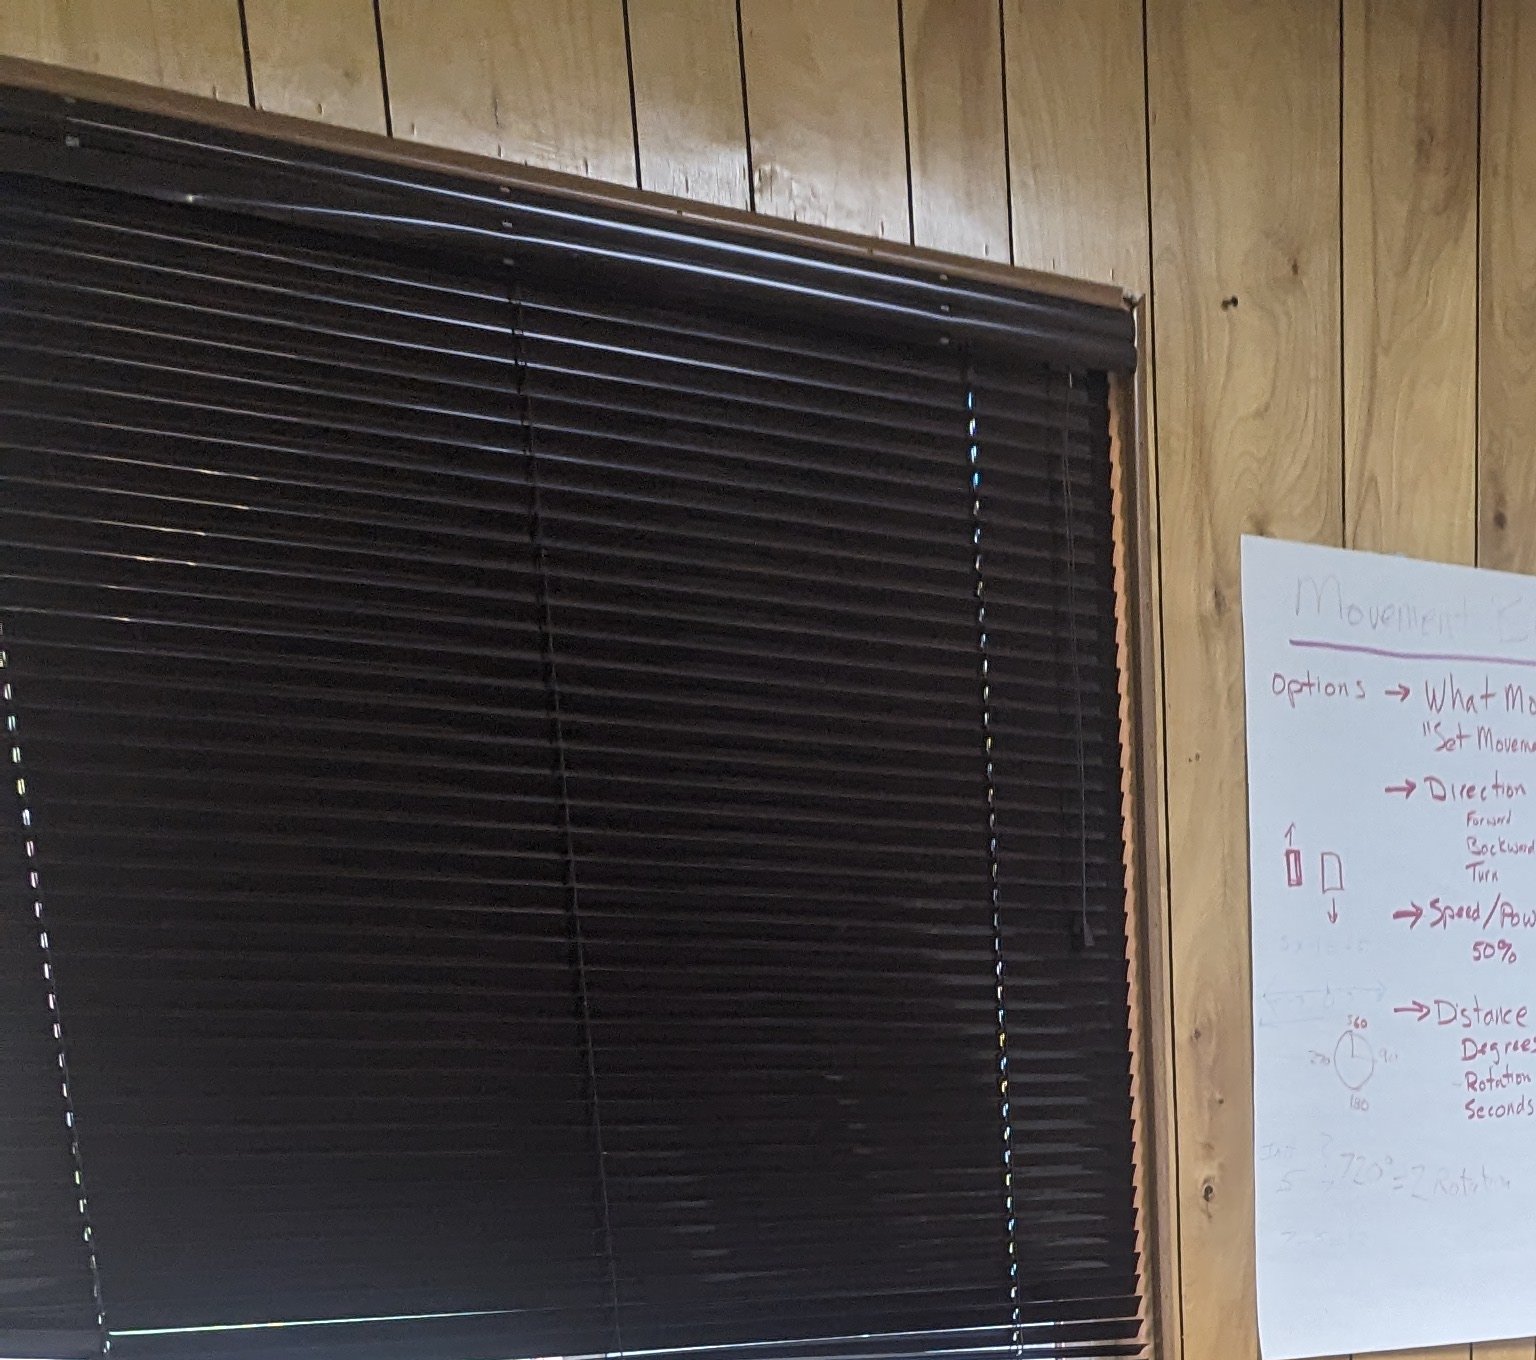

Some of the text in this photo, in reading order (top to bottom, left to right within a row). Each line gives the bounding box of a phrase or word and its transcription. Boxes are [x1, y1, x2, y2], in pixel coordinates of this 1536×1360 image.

[1295, 574, 1470, 641] Movement
[1271, 670, 1367, 709] Options
[1424, 672, 1496, 714] What
[1422, 769, 1528, 802] Direction
[1465, 809, 1513, 828] Forward
[1464, 860, 1500, 883] Turn
[1472, 938, 1519, 965] 50%
[1433, 995, 1529, 1028] Distance
[1465, 1092, 1535, 1120] Seconds
